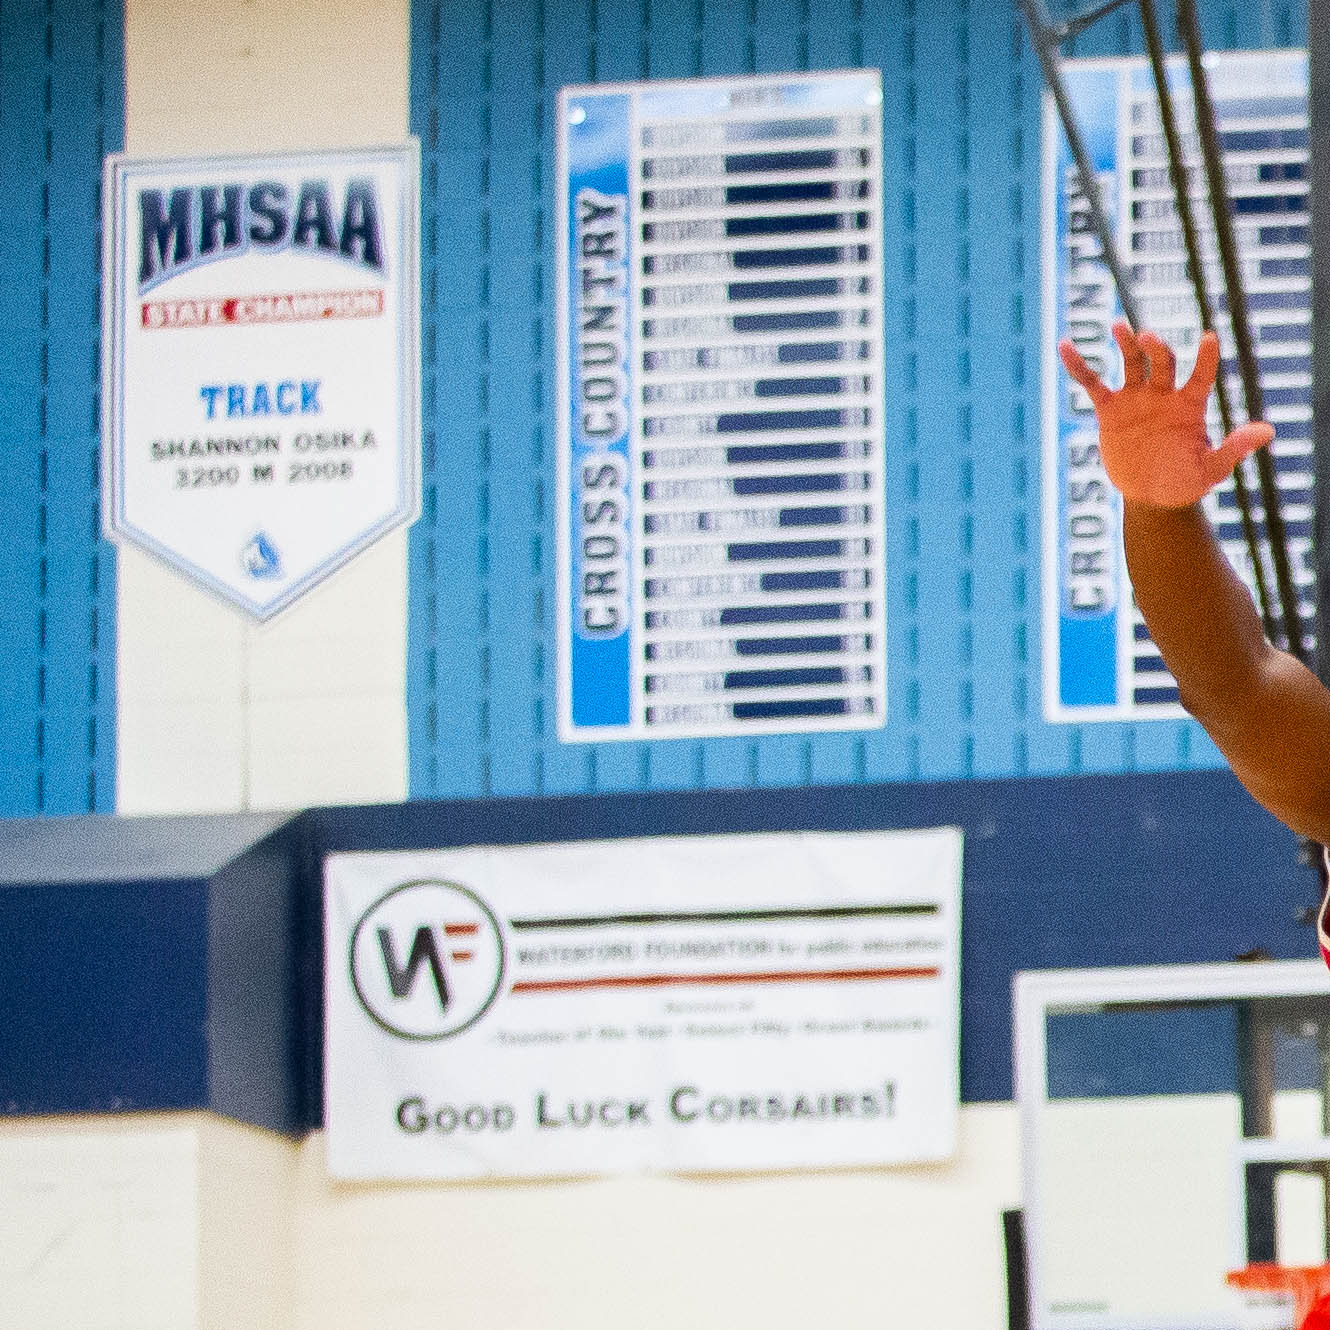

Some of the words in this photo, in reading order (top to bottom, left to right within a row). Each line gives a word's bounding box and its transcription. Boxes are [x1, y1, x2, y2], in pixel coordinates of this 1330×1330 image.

[138, 176, 387, 286] MHSAA
[147, 299, 222, 327] STATE
[581, 198, 619, 437] COUNTRY
[199, 379, 322, 420] TRACK
[150, 432, 281, 462] SHANNON
[293, 427, 378, 455] OSIKA
[252, 462, 274, 485] M
[582, 463, 620, 632] CROSS
[1069, 444, 1106, 611] CROSS
